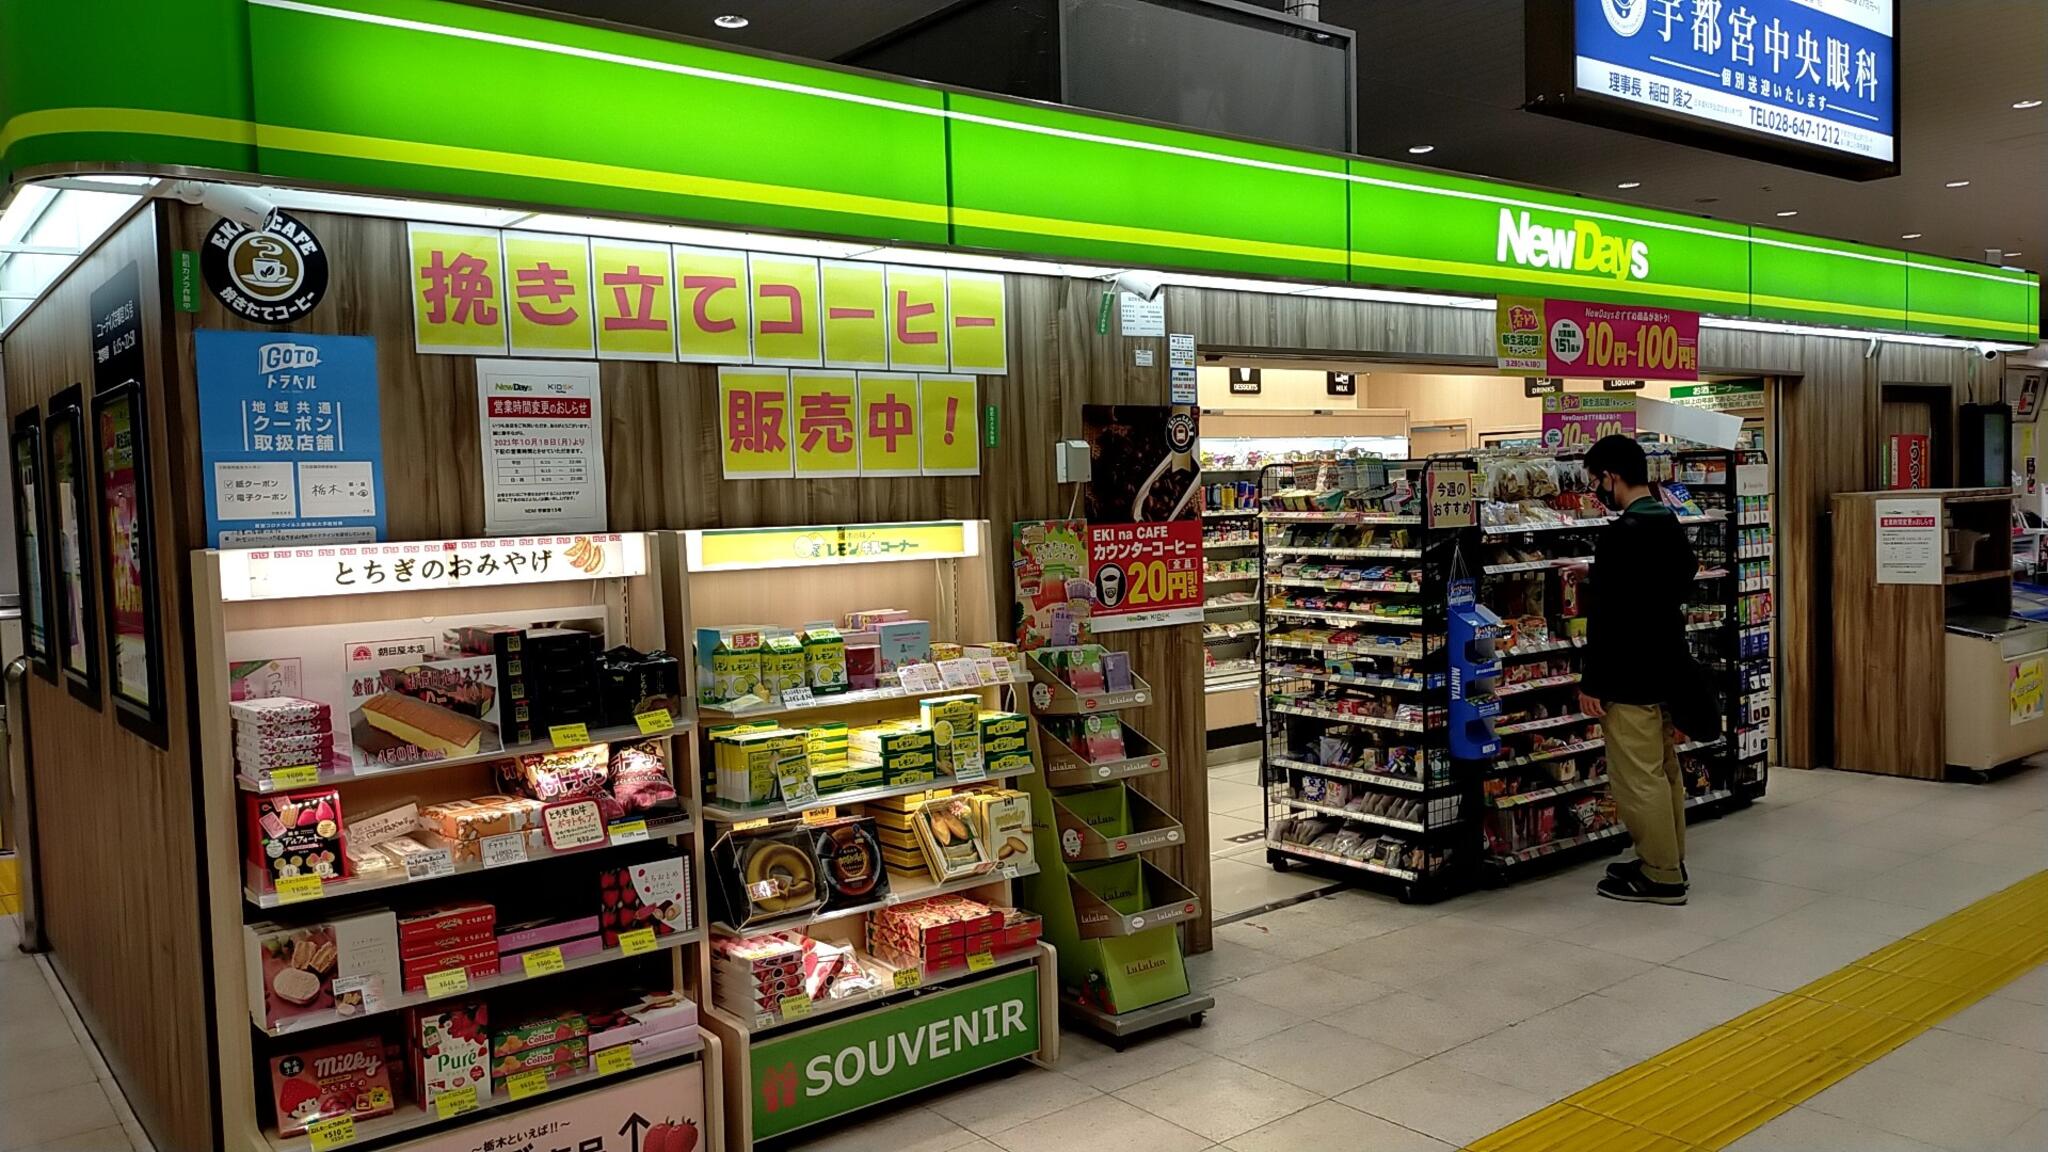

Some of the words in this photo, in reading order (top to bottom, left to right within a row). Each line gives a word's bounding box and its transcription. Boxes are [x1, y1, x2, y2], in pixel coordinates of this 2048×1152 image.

[1652, 0, 1878, 102] 宇都宮中央眼科
[1608, 71, 1642, 97] 理事長
[1648, 81, 1670, 104] 稲田
[1673, 87, 1693, 110] 隆之
[1720, 67, 1828, 111] 個別送迎いたします
[1497, 207, 1649, 282] NewDays
[219, 286, 315, 321] 挽きたてコーヒー
[421, 250, 996, 345] 挽き立てコーヒー
[266, 374, 317, 390] トラベル
[495, 382, 534, 392] NewDays
[1531, 386, 1556, 394] DRINKS
[251, 400, 332, 415] 地域共通
[493, 399, 588, 415] 営業時間変更のおしらせ
[253, 415, 333, 432] クーポン
[727, 389, 959, 455] 販売中!
[253, 434, 335, 452] 取扱店舗
[235, 480, 279, 489] 紙クーポン
[1436, 481, 1466, 497] 今週の
[236, 493, 288, 502] 電子クーポン
[1432, 501, 1472, 517] おすすめ
[1093, 528, 1116, 542] EKI
[1118, 530, 1134, 540] na
[1136, 525, 1169, 540] CAFE
[1094, 539, 1197, 560] カウンターコーヒー
[335, 552, 553, 587] とちぎのおみやげ
[734, 633, 760, 648] 見本
[377, 644, 426, 657] 朝日屋本店
[1451, 666, 1461, 700] MINTIA
[804, 998, 1028, 1098] SOUVENIR
[314, 1052, 382, 1077] Milky
[437, 1049, 477, 1073] Puré
[321, 1079, 366, 1095] とちおとめ
